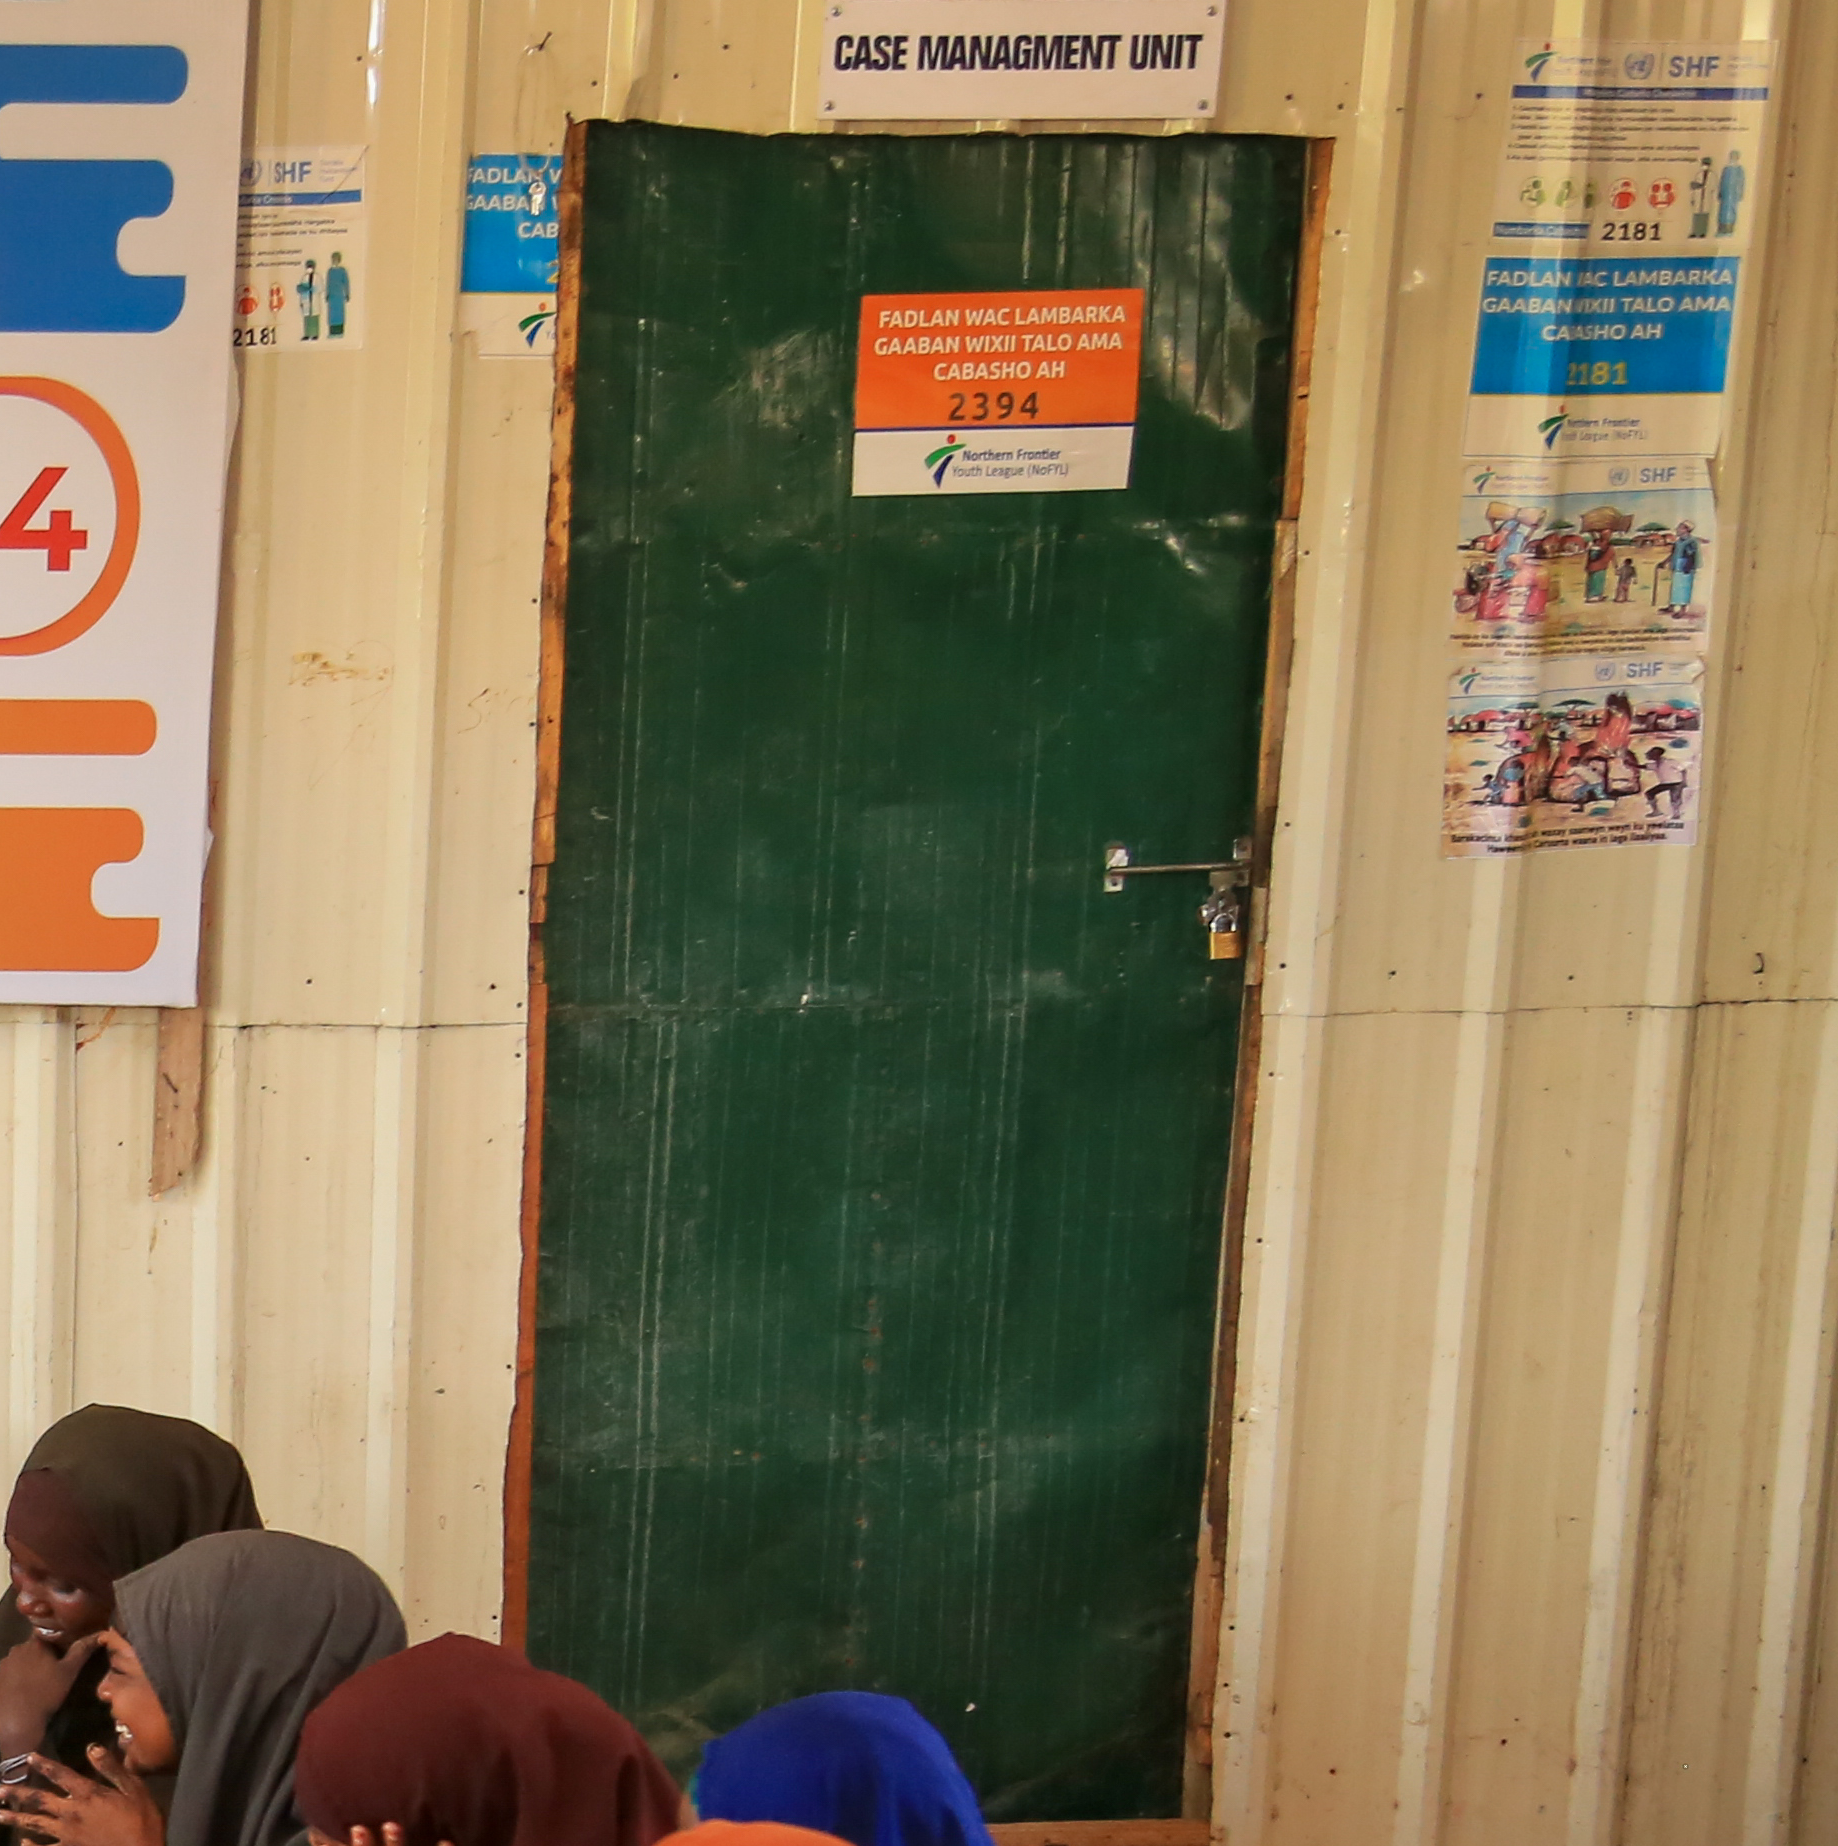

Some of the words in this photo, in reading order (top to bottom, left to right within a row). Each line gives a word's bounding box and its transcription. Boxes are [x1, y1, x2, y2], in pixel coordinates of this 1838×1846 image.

[834, 34, 909, 71] CASE
[917, 34, 1122, 71] MANAGMENT
[1129, 34, 1203, 71] UNIT
[1668, 56, 1721, 78] SHF
[274, 160, 312, 183] SHF
[466, 194, 545, 211] AABA
[1601, 222, 1661, 241] 2181
[1485, 270, 1572, 287] FADLAN
[1613, 269, 1734, 287] LAMBARKA
[1482, 297, 1573, 314] GAABAN
[1621, 297, 1674, 314] TALO
[1678, 296, 1732, 313] AMA
[878, 309, 960, 328] FADLAN
[965, 308, 1010, 327] WAC
[1014, 305, 1126, 326] LAMBARKA
[233, 328, 277, 347] 2181
[1630, 324, 1664, 340] AH
[874, 336, 960, 356] GAABAN
[965, 334, 1017, 354] WIXII
[1021, 333, 1073, 352] TALO
[1076, 332, 1123, 351] AMA
[933, 361, 1032, 381] CABASHO
[1036, 360, 1066, 379] AH
[948, 391, 1039, 421] 2394
[962, 449, 1013, 462] Northern
[1016, 448, 1061, 461] Frontier
[951, 464, 982, 478] Youth
[985, 464, 1024, 480] League
[1640, 467, 1676, 483] SHF
[1626, 662, 1663, 678] SHF
